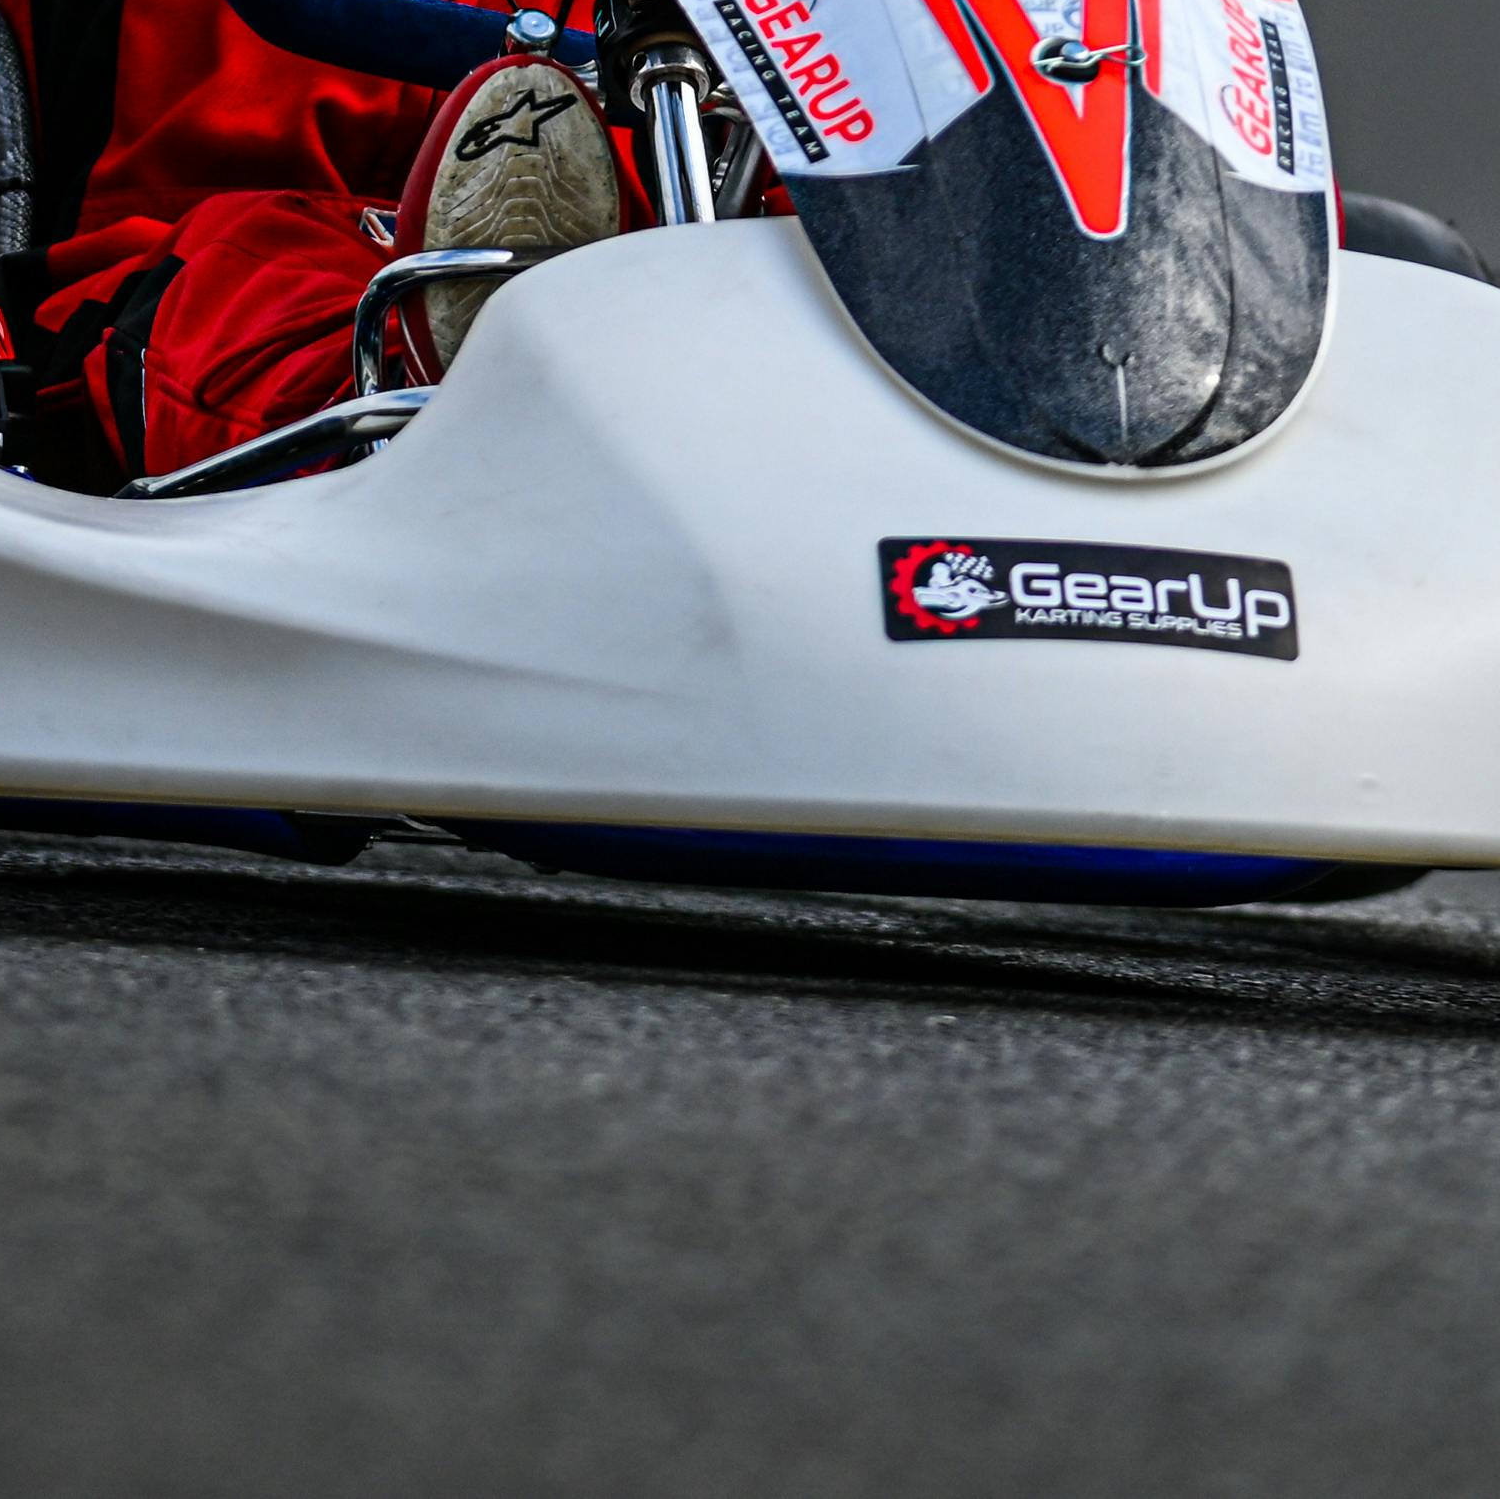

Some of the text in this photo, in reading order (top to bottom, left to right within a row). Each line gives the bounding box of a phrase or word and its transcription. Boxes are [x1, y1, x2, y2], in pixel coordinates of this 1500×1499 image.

[720, 3, 777, 81] RACING
[777, 95, 822, 155] TEAM
[1264, 21, 1292, 167] RACING TEAM
[1008, 561, 1291, 639] GearUp
[1014, 607, 1244, 640] KARTING SUPPLIES
